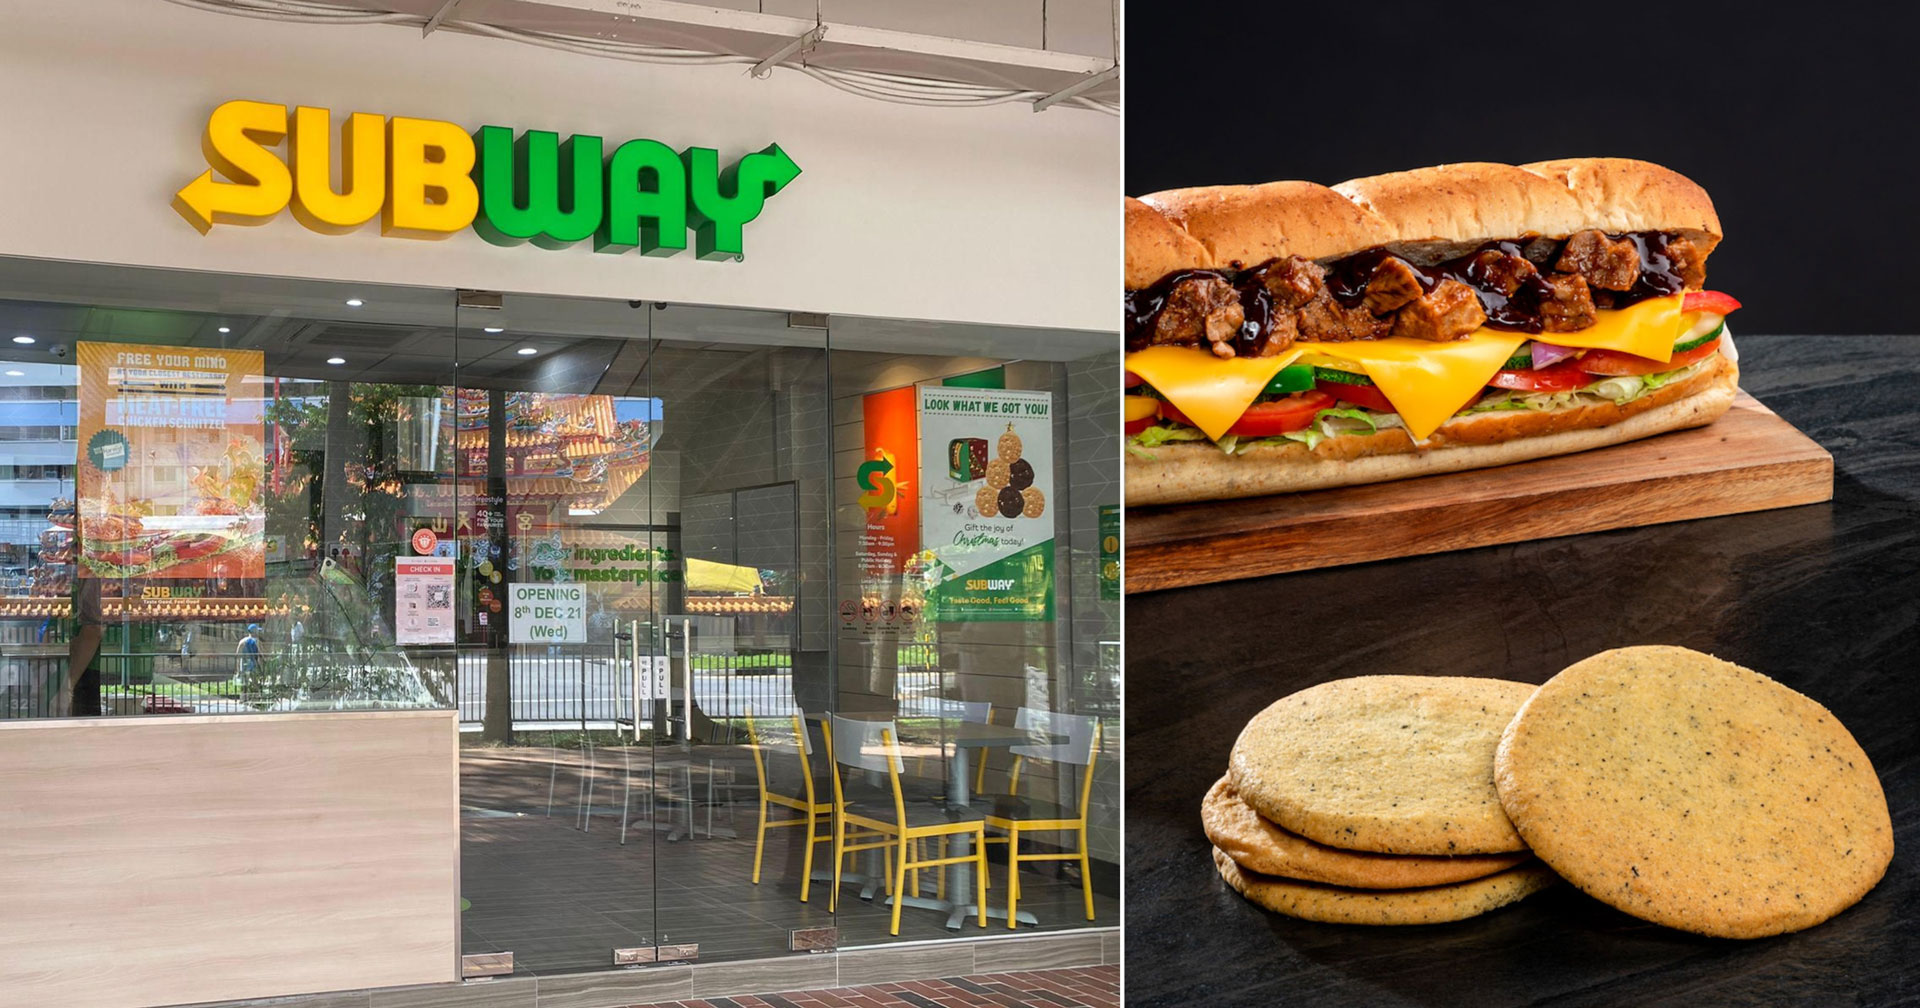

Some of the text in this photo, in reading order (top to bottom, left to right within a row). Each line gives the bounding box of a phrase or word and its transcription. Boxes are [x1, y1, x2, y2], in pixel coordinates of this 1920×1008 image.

[174, 99, 802, 262] SUBWAY
[117, 352, 227, 370] FREE YOUR MIND
[149, 370, 181, 379] CLOSEST
[160, 382, 187, 390] WITH
[924, 398, 1048, 415] LOOK WHAT WE GOT YOU!
[118, 415, 227, 430] CHICKEN SCHNITZEL
[477, 509, 494, 518] 40+
[964, 523, 979, 531] Gift
[980, 523, 993, 531] the
[993, 523, 1005, 533] joy
[953, 530, 1025, 547] Christmas today!
[965, 579, 1015, 591] SUBWAY
[141, 586, 206, 600] SUBWAY
[516, 588, 580, 601] OPENING
[1009, 596, 1029, 604] Good
[514, 605, 531, 619] 8th
[534, 607, 564, 619] DEC
[567, 607, 582, 619] 21
[529, 625, 568, 640] (Wed)
